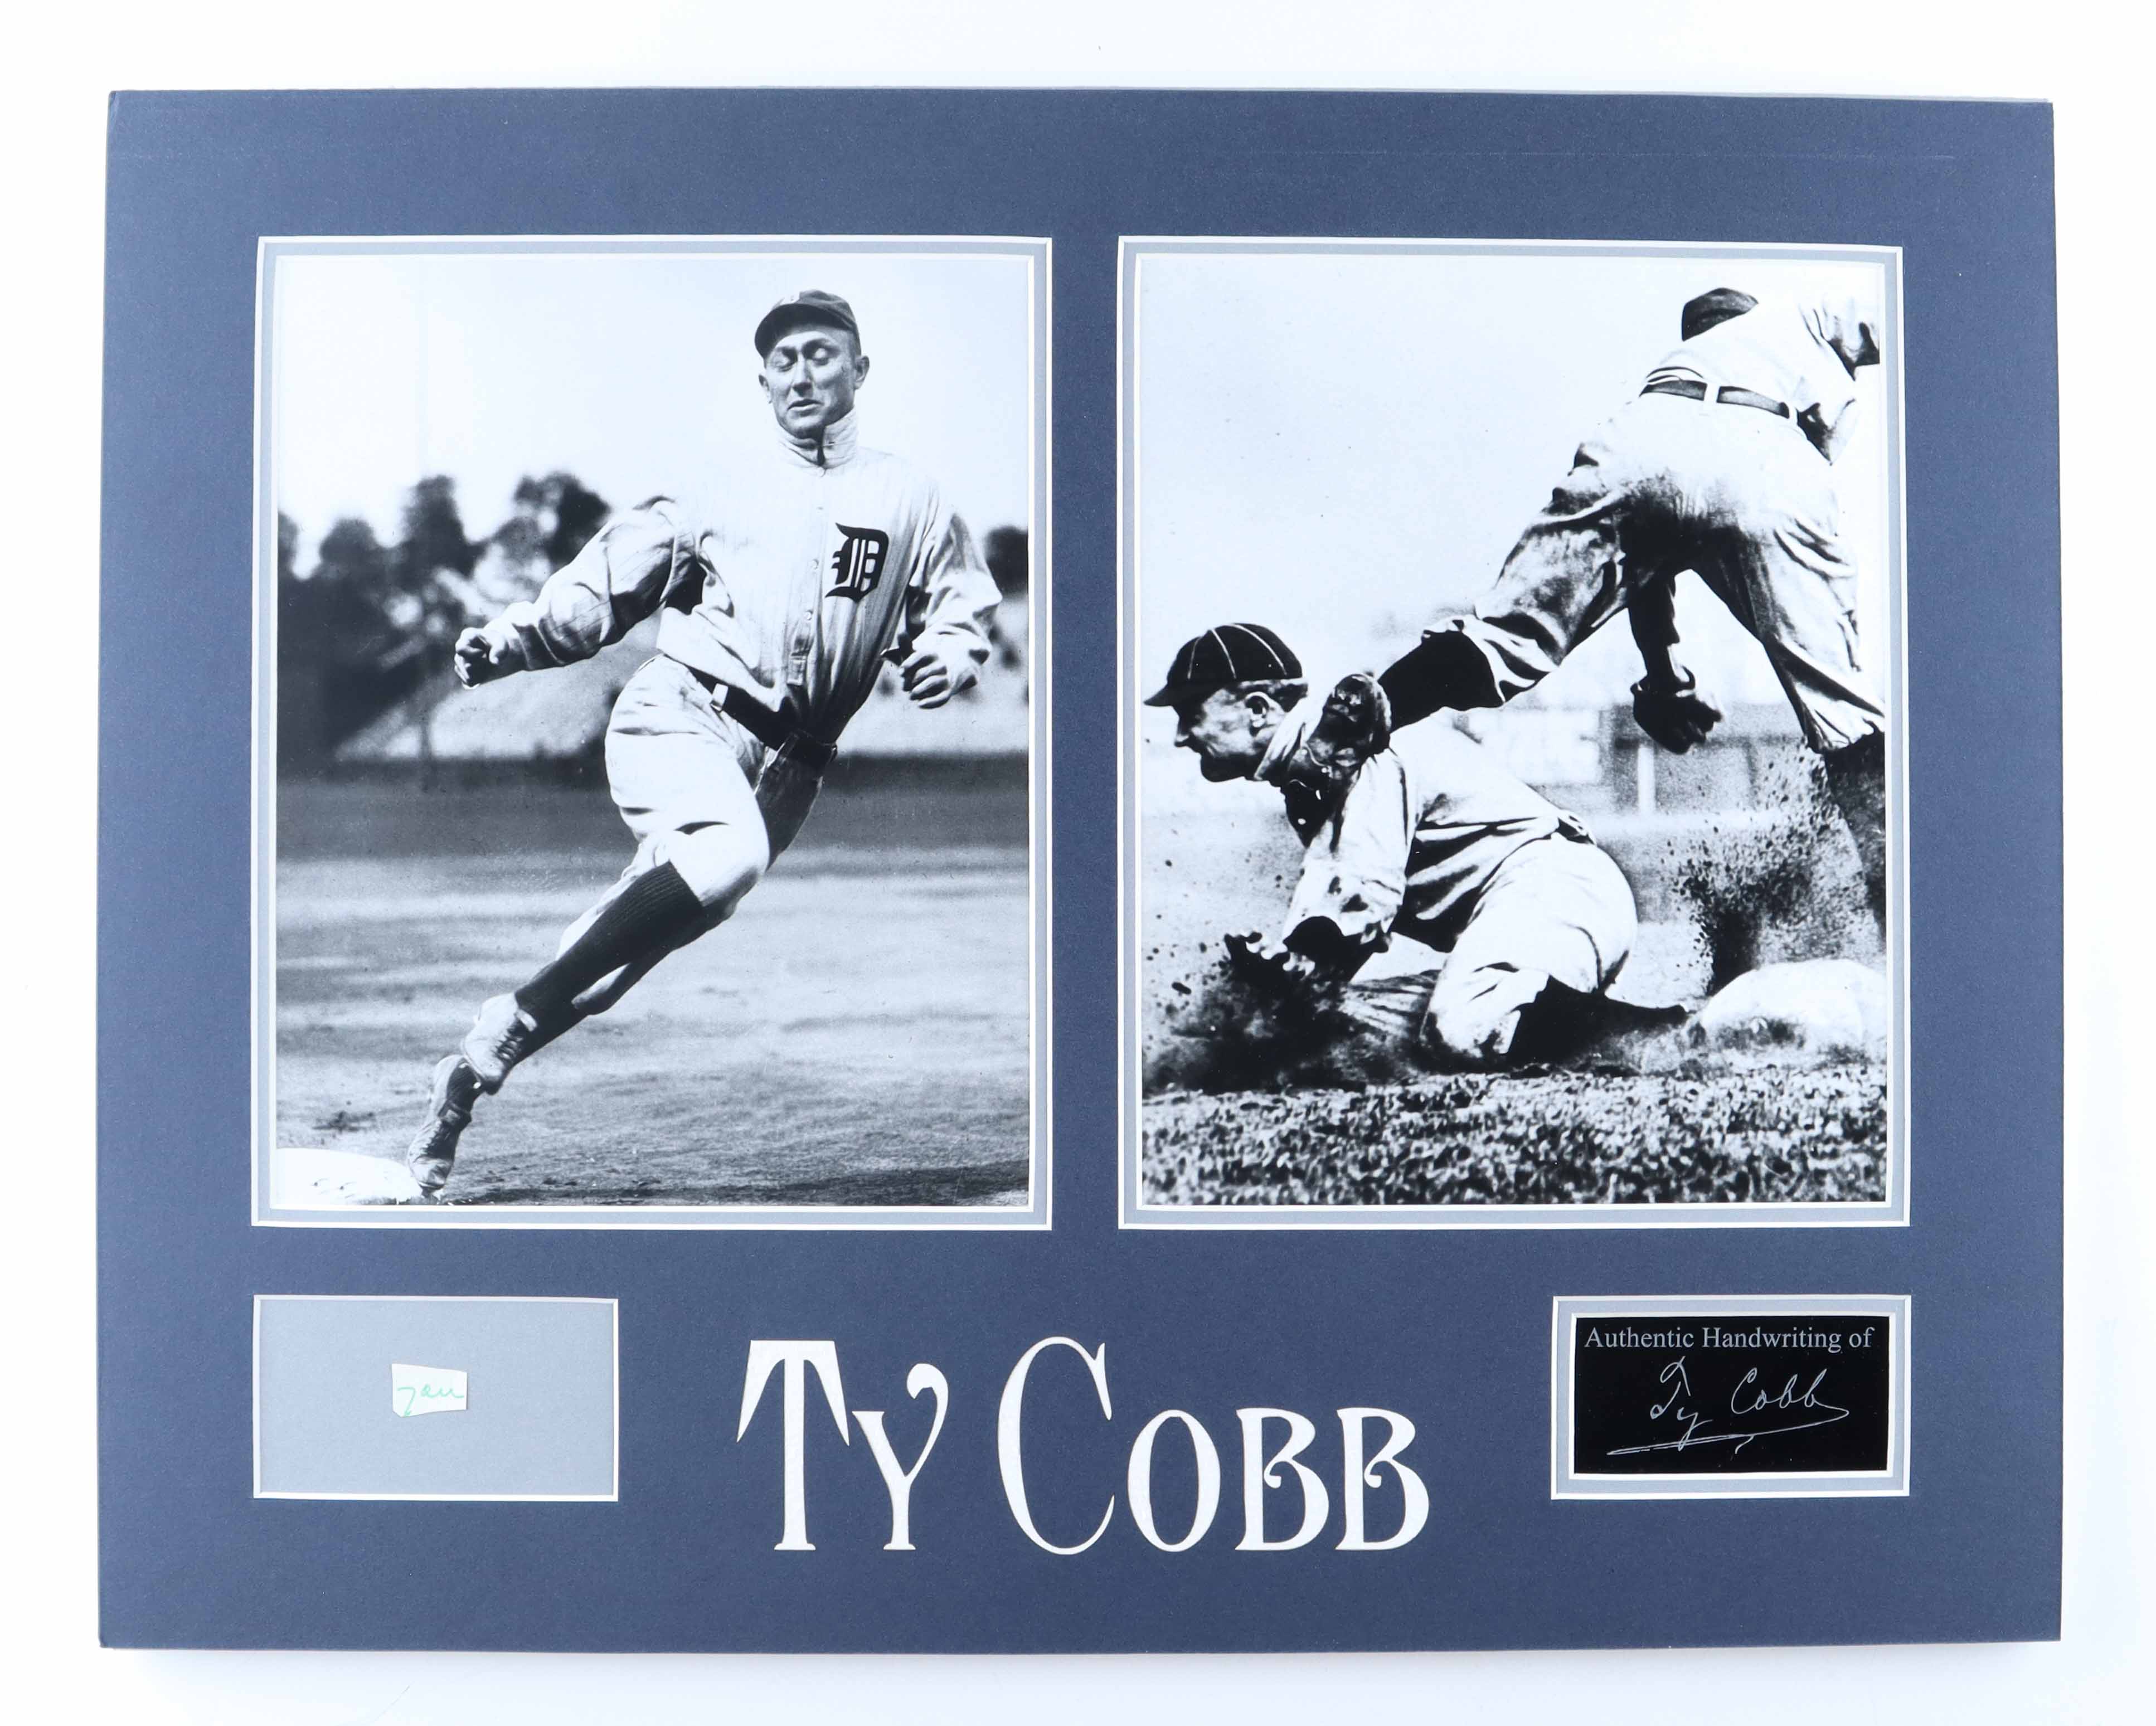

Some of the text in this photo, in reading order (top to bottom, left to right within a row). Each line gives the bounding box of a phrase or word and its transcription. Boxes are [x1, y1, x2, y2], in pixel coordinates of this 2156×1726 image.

[825, 522, 889, 604] D
[1584, 1326, 1876, 1354] Authentic Handwriting of
[1649, 1355, 1849, 1451] Ty Cobb
